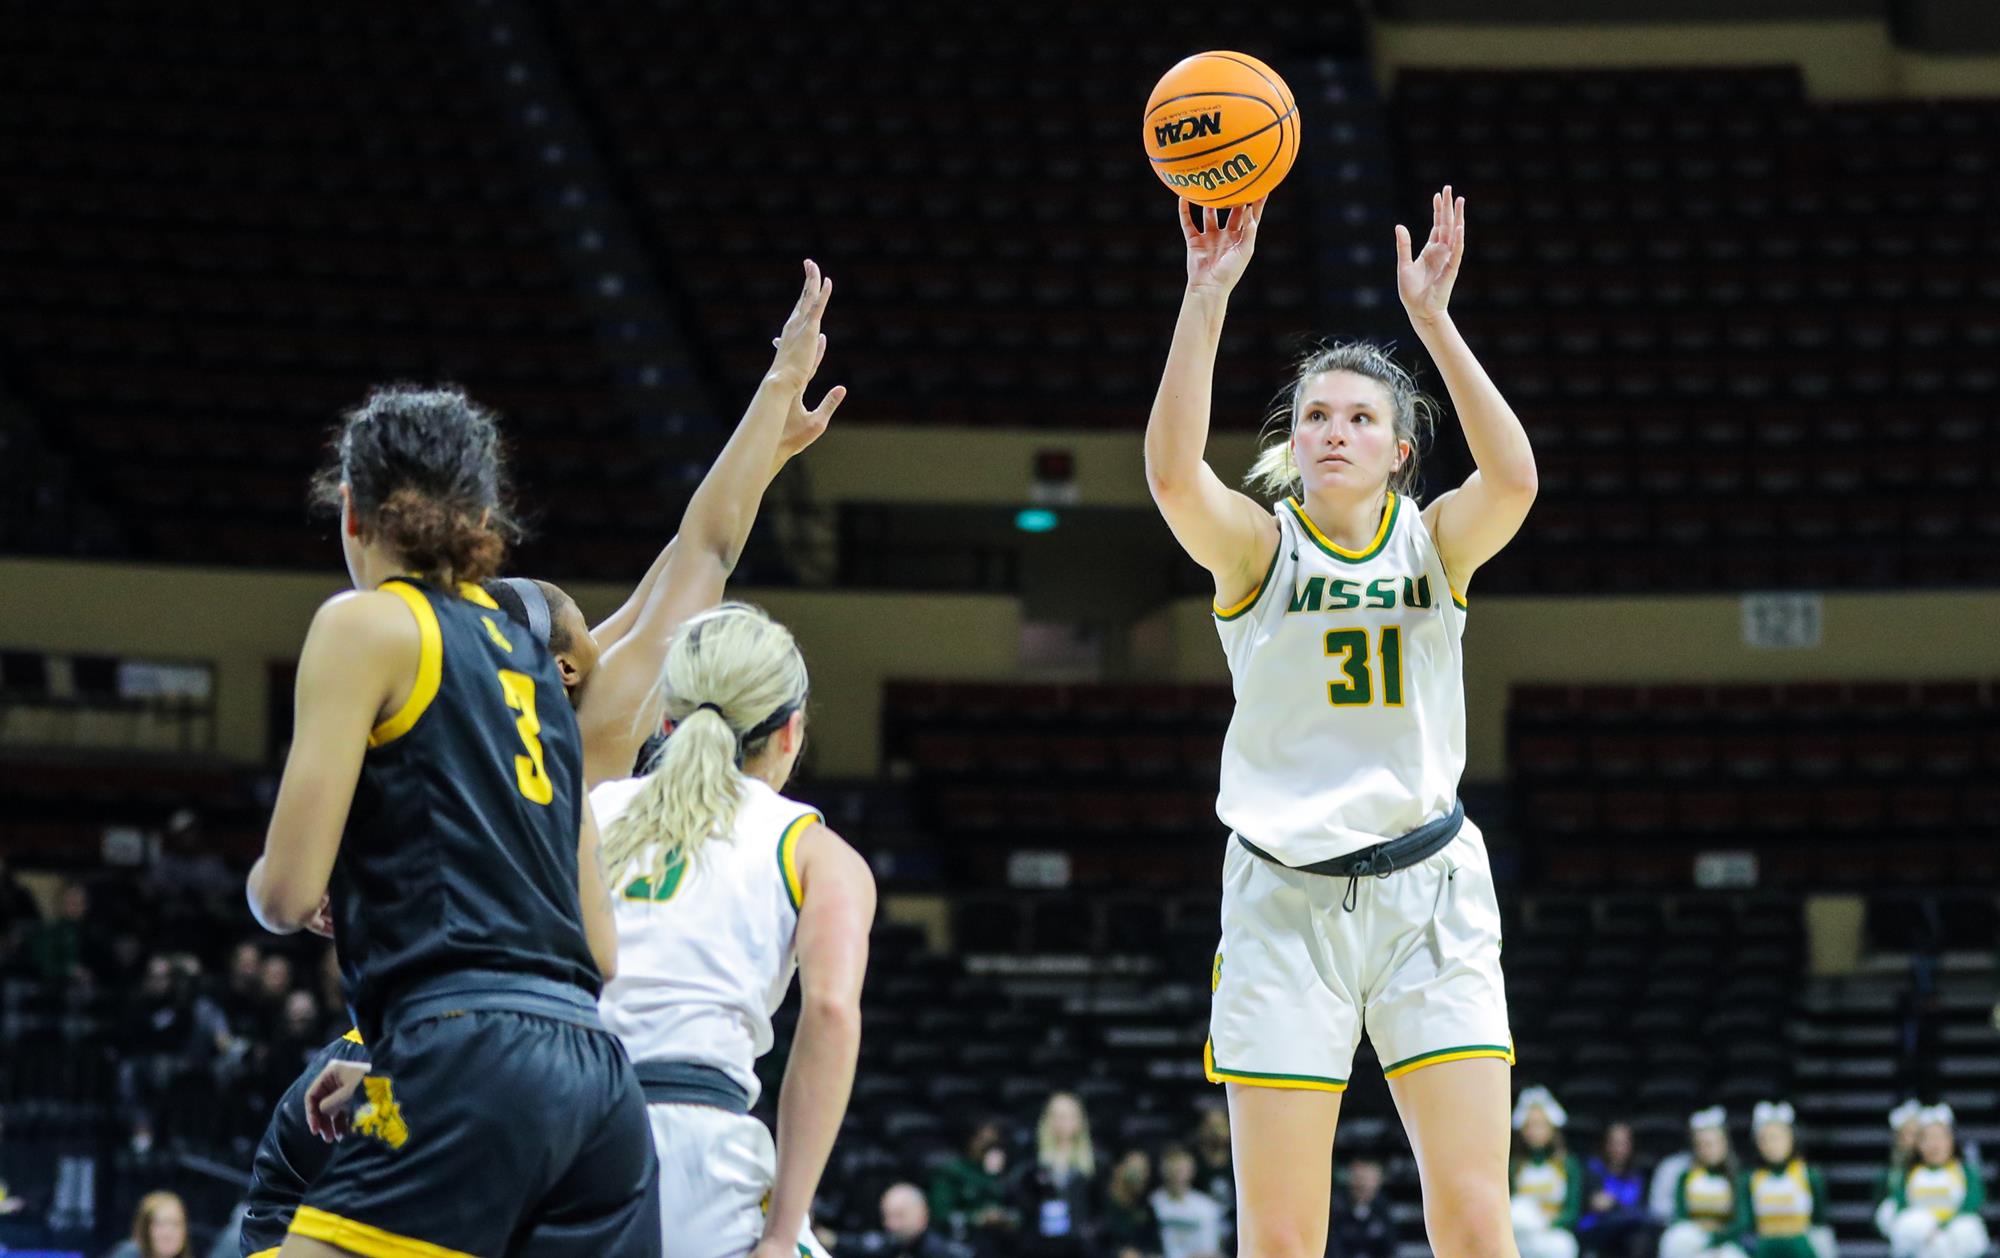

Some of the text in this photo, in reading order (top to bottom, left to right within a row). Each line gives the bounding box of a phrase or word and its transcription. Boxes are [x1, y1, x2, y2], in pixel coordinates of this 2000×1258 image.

[1154, 111, 1221, 148] NCAA
[1161, 153, 1257, 191] Wilson
[1287, 572, 1432, 614] MSSU
[1323, 625, 1404, 707] 31
[498, 669, 553, 805] 3
